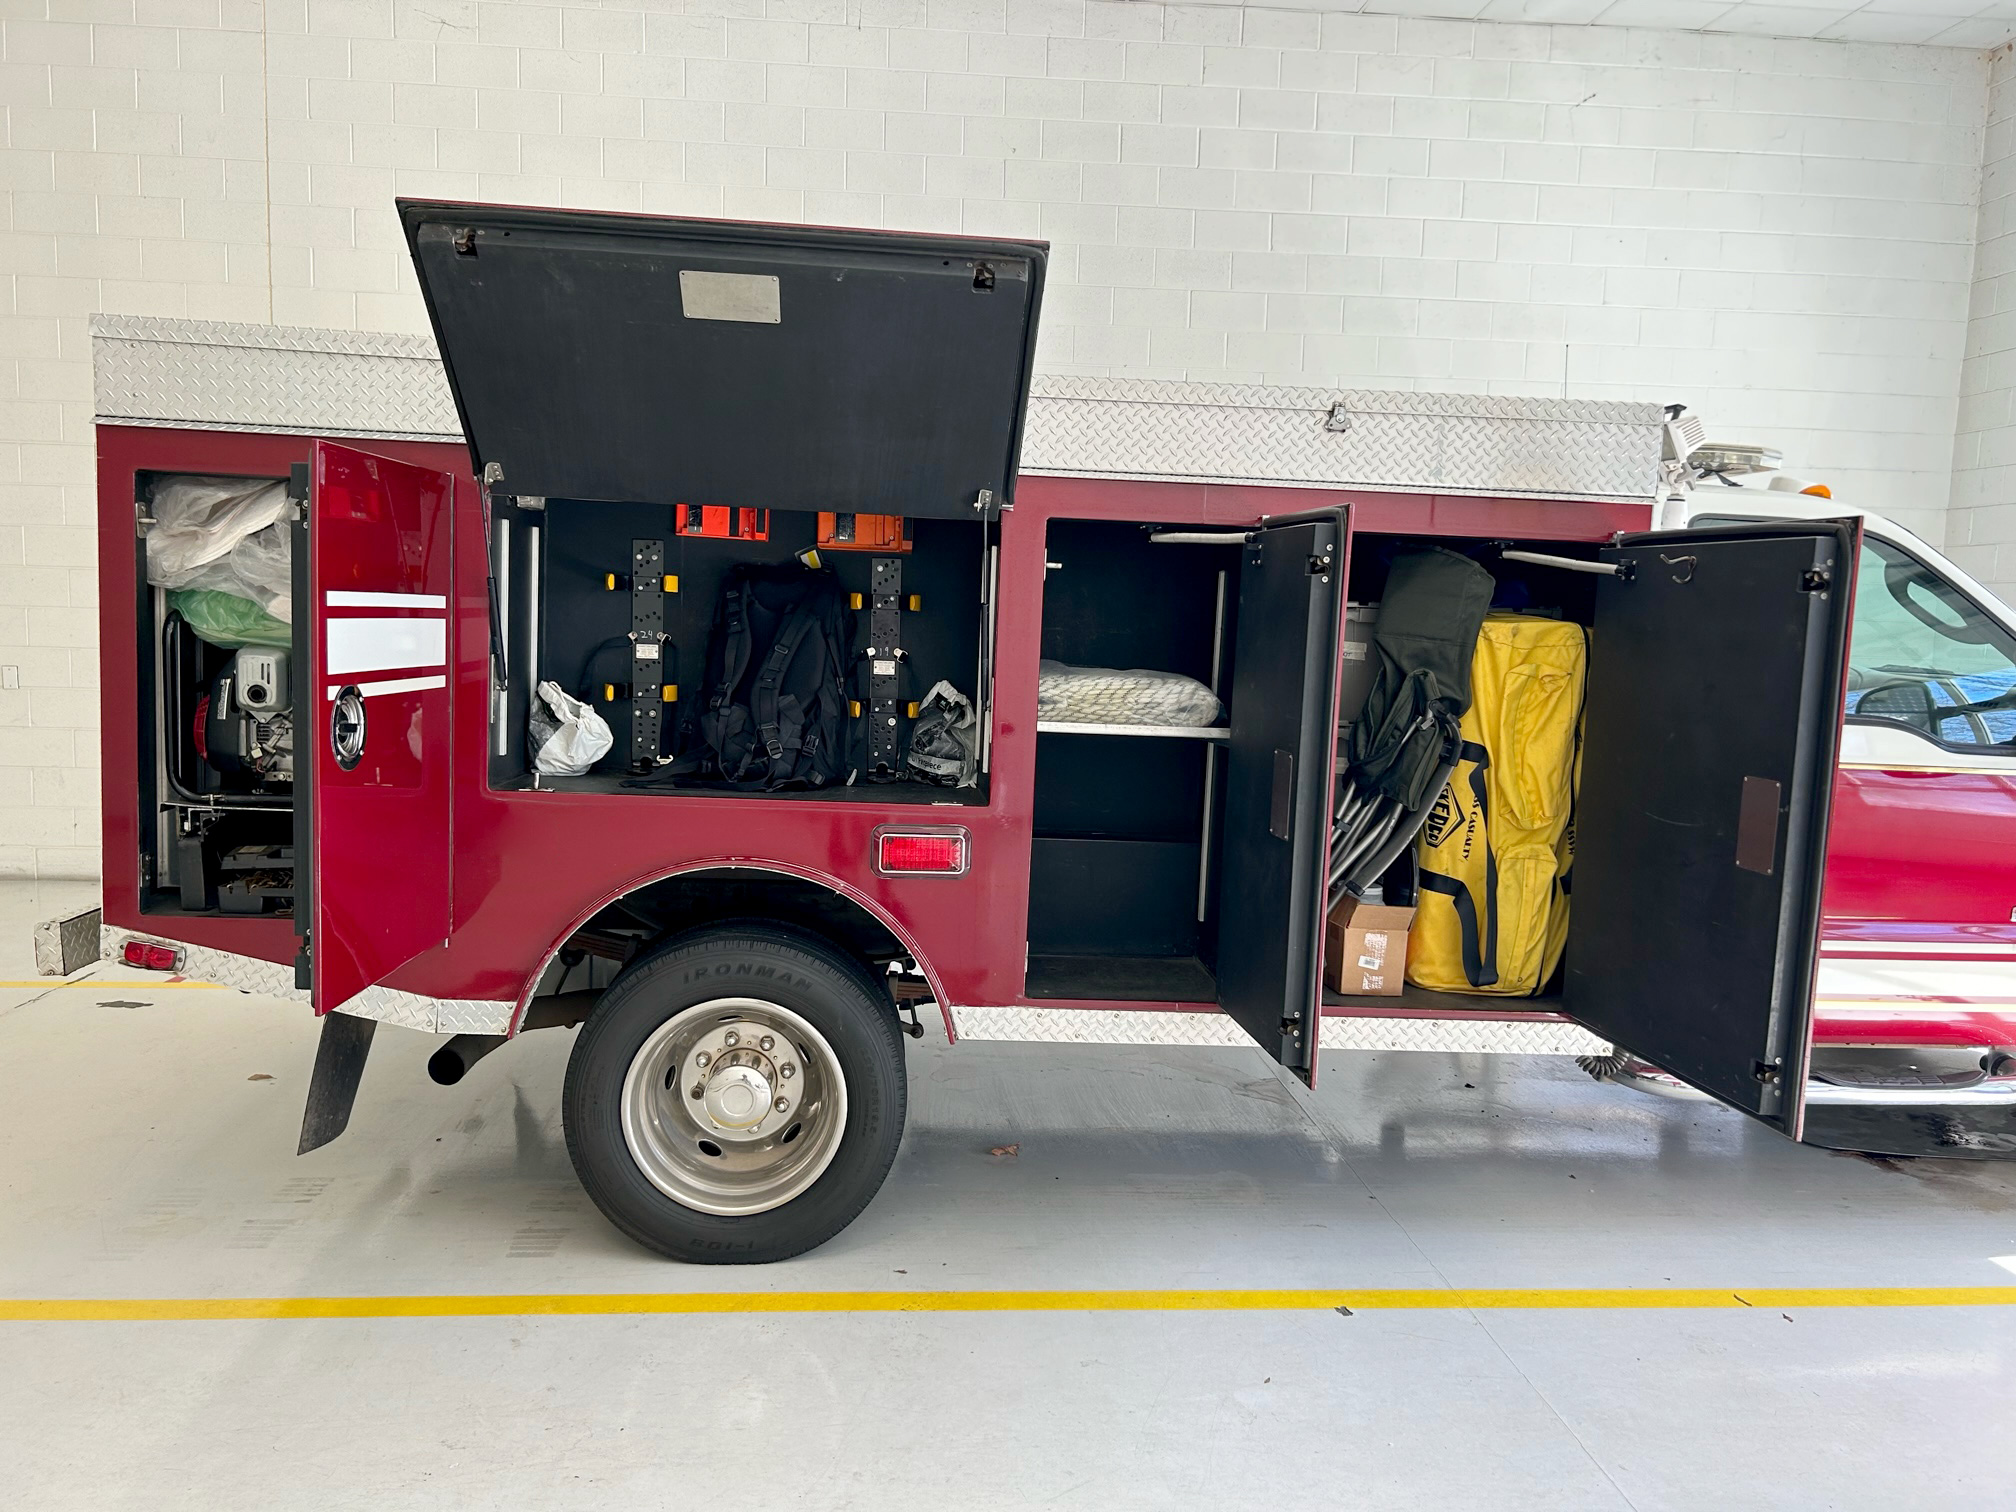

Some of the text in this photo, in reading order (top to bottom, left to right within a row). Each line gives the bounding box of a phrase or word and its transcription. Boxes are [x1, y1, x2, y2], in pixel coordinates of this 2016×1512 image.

[640, 630, 653, 640] 24
[879, 646, 889, 657] 19
[1462, 811, 1478, 861] CASUALTY
[683, 963, 814, 993] IRONMAN
